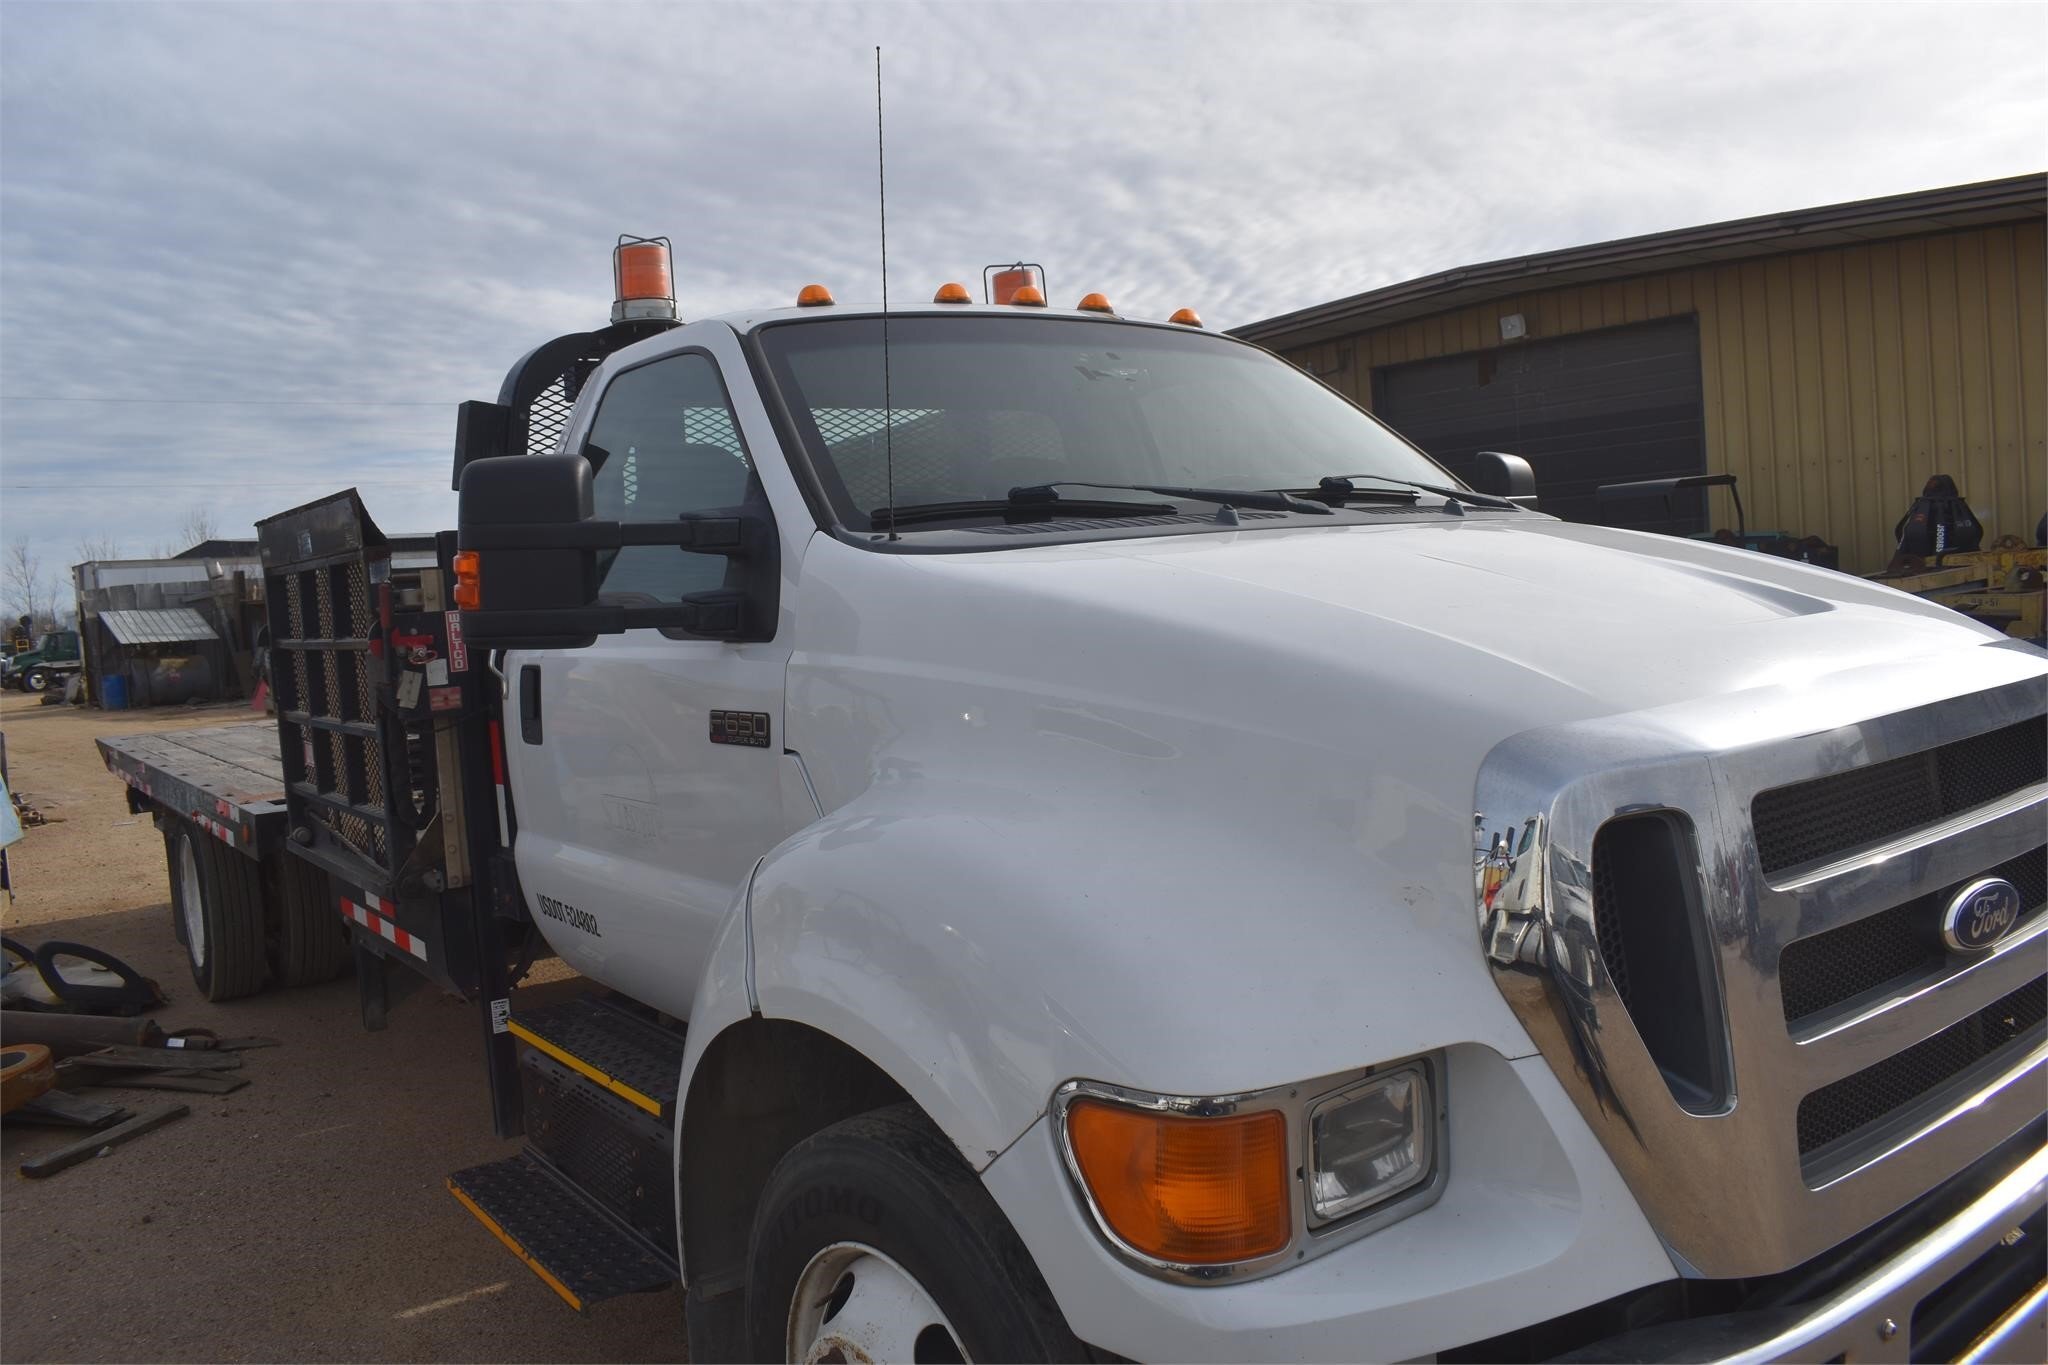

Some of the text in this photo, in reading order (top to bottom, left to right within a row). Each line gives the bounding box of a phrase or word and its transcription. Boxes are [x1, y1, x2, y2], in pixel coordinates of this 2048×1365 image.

[448, 612, 465, 670] WALTCO
[750, 737, 767, 746] DUTY
[536, 892, 568, 924] USDOT
[1971, 892, 2010, 939] Ford
